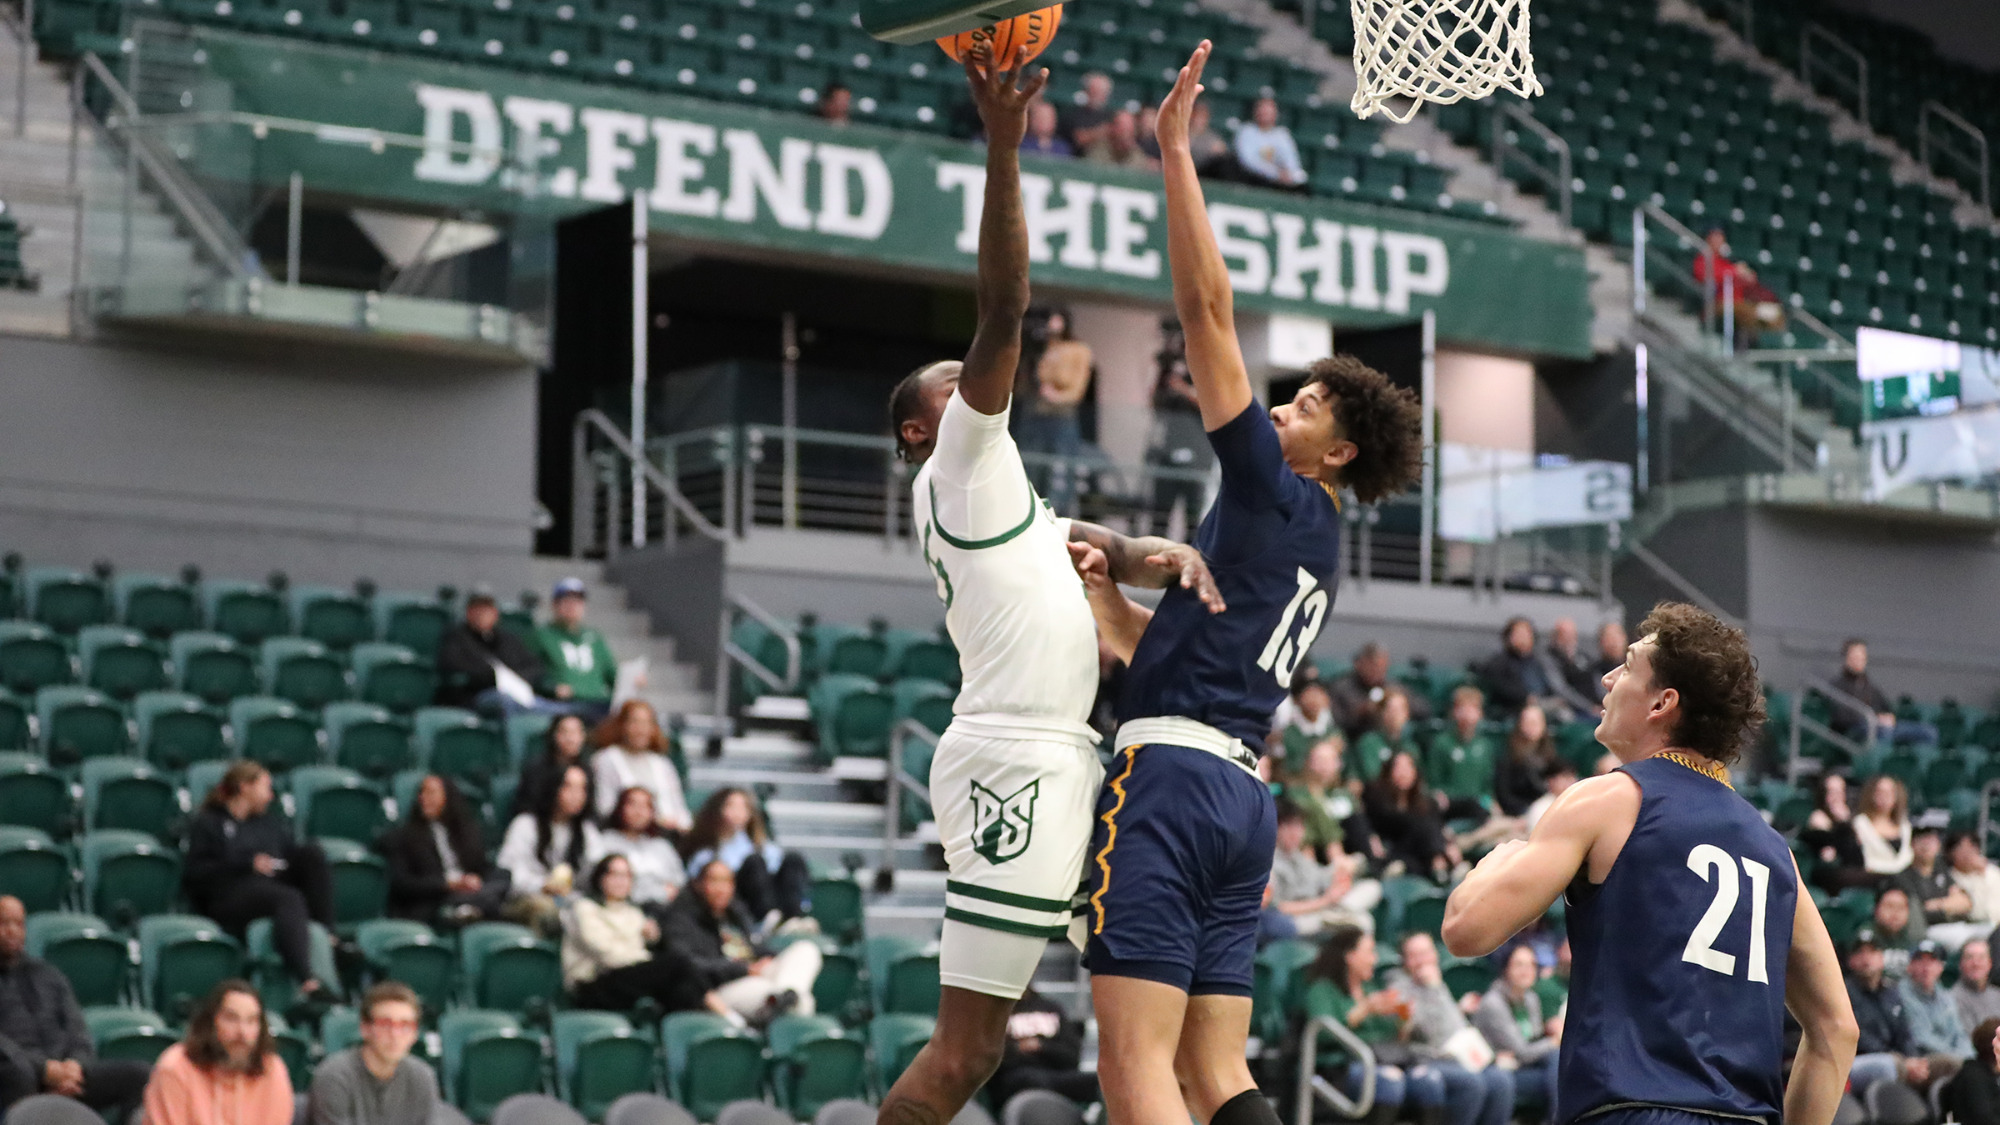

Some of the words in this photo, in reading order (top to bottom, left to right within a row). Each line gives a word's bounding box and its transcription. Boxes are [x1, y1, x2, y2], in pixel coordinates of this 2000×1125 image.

[414, 84, 894, 239] DEFEND
[936, 162, 1162, 279] THE
[1207, 201, 1450, 314] SHIP
[1256, 565, 1328, 689] 13
[1681, 843, 1771, 986] 21
